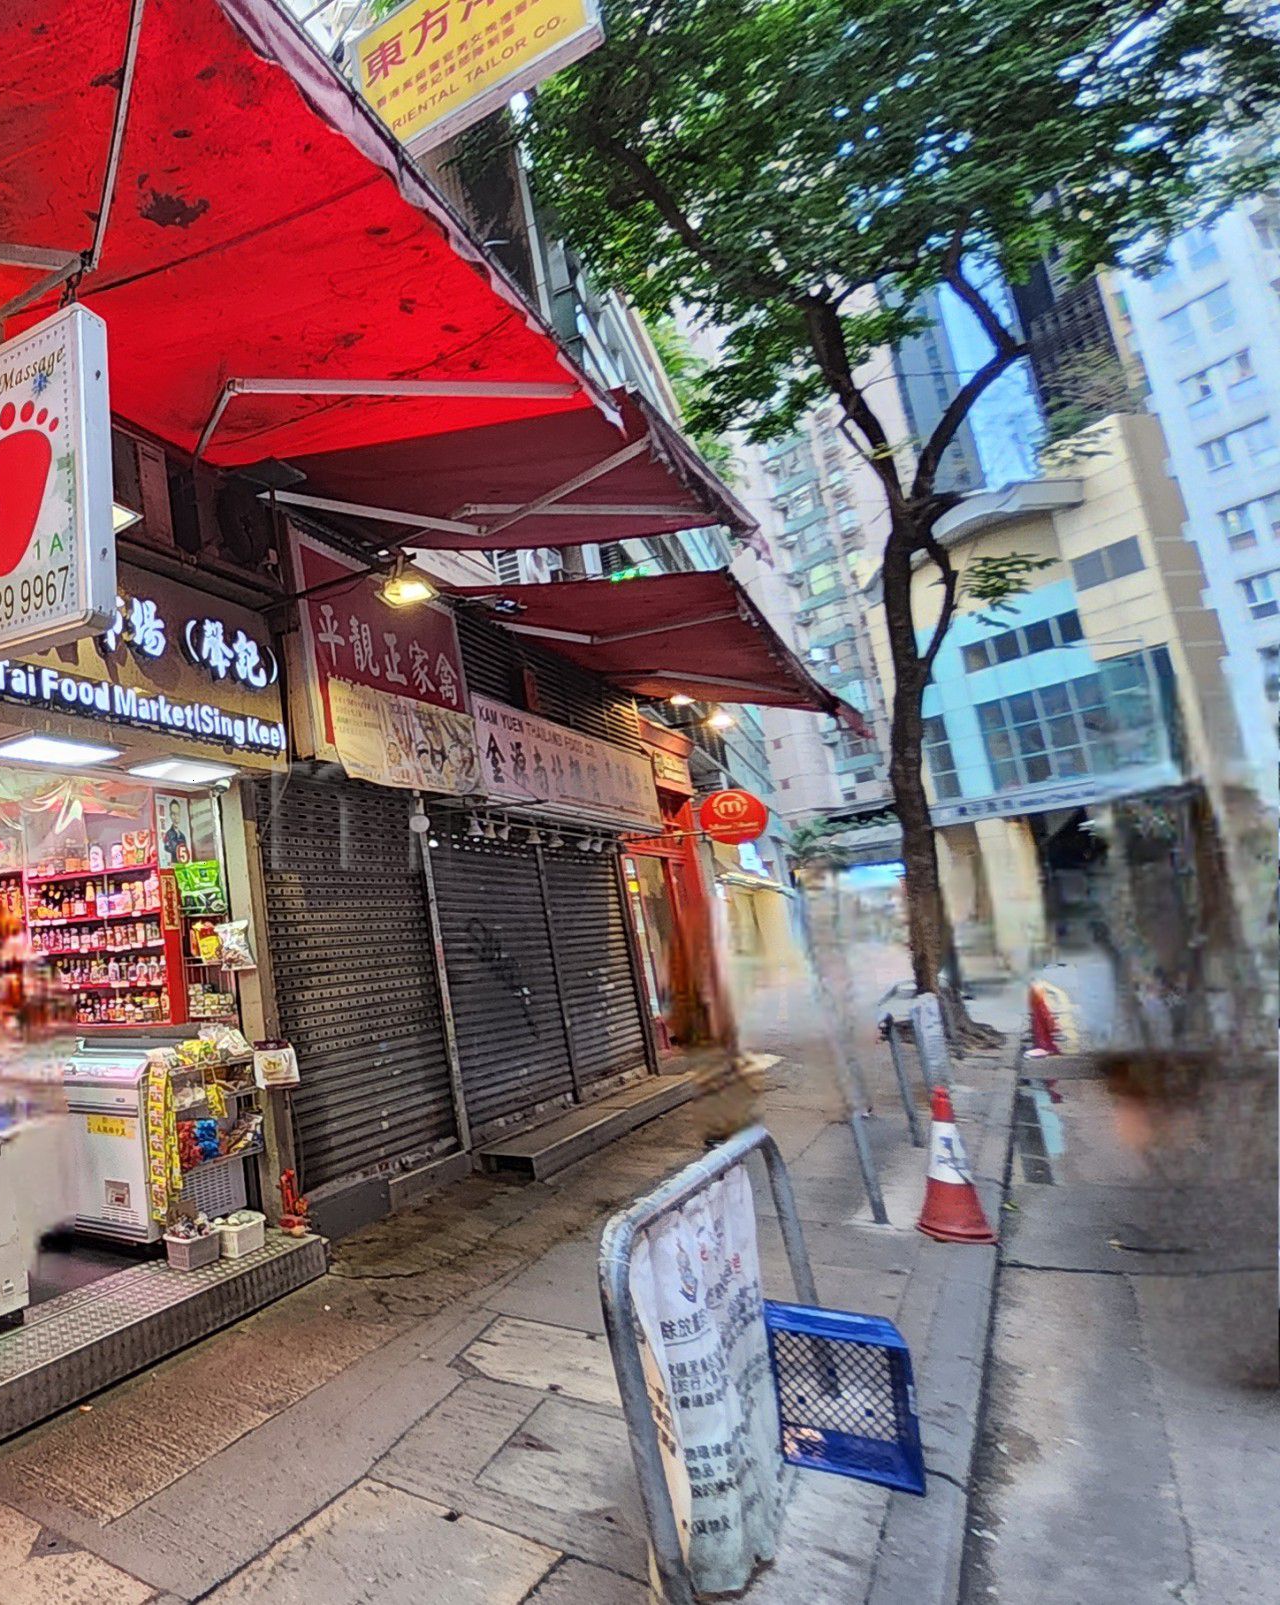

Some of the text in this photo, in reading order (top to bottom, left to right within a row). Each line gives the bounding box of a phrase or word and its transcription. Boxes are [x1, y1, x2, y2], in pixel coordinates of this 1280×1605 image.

[463, 38, 528, 84] TAILOR
[533, 16, 567, 39] CO.
[21, 565, 70, 614] 9967
[318, 604, 458, 706] 平靚正家禽
[41, 668, 110, 711] Food
[477, 705, 498, 726] KAM
[500, 713, 524, 734] YUEN
